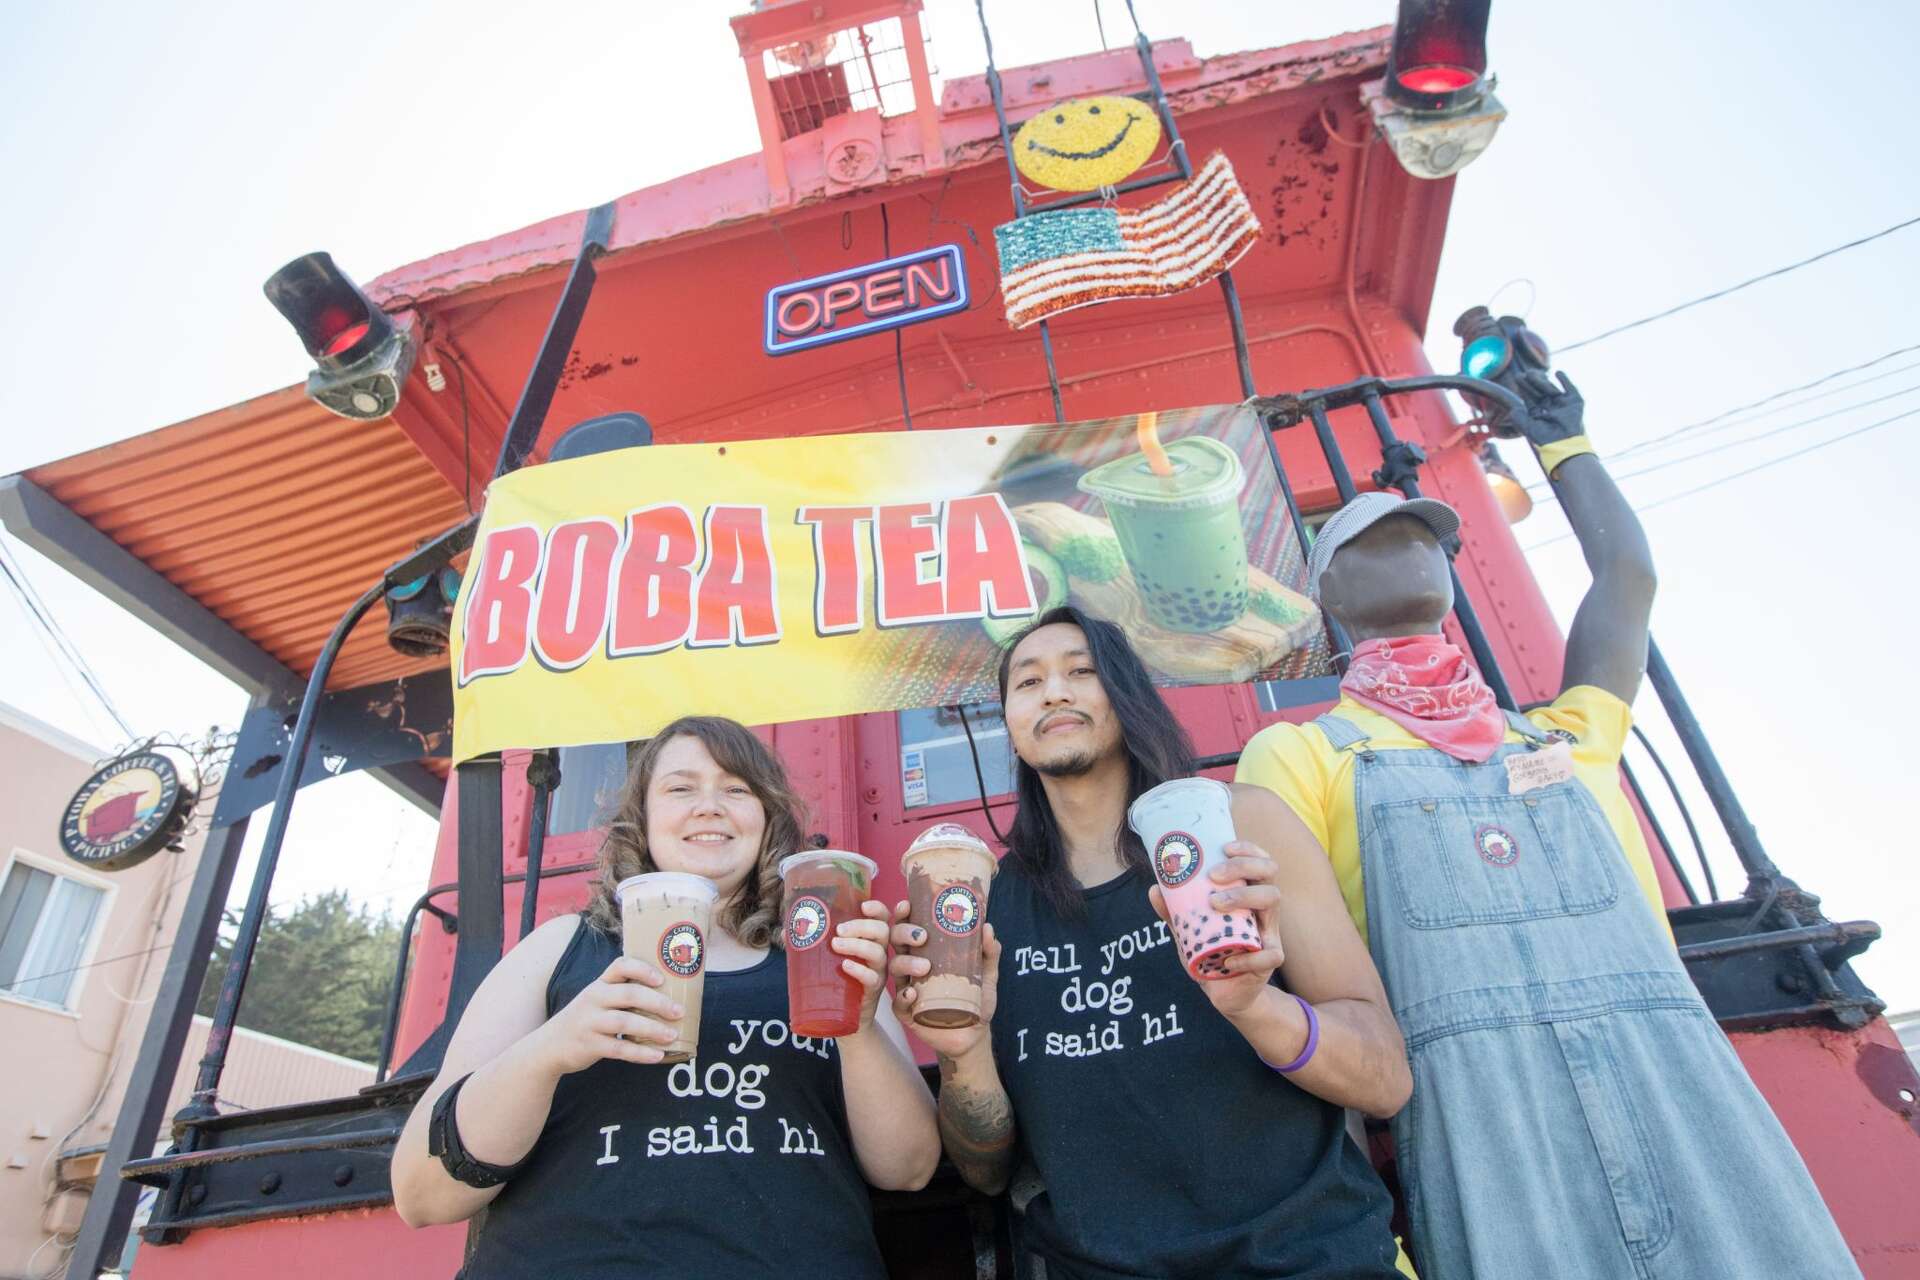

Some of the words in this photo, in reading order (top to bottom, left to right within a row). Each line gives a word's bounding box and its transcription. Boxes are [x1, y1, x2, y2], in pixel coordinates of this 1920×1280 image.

[777, 256, 952, 335] OPEN
[458, 502, 783, 688] BOBA
[795, 492, 1039, 638] TEA
[101, 757, 156, 781] COFFEE
[161, 770, 175, 799] TEA
[1015, 944, 1082, 976] Tell
[1100, 920, 1171, 975] your
[1061, 976, 1133, 1015] dog
[1017, 1028, 1028, 1062] I
[1045, 1021, 1124, 1057] said
[1142, 1004, 1184, 1045] hi
[668, 1056, 770, 1109] dog
[597, 1124, 621, 1165] I
[647, 1116, 754, 1157] said
[778, 1118, 825, 1156] hi
